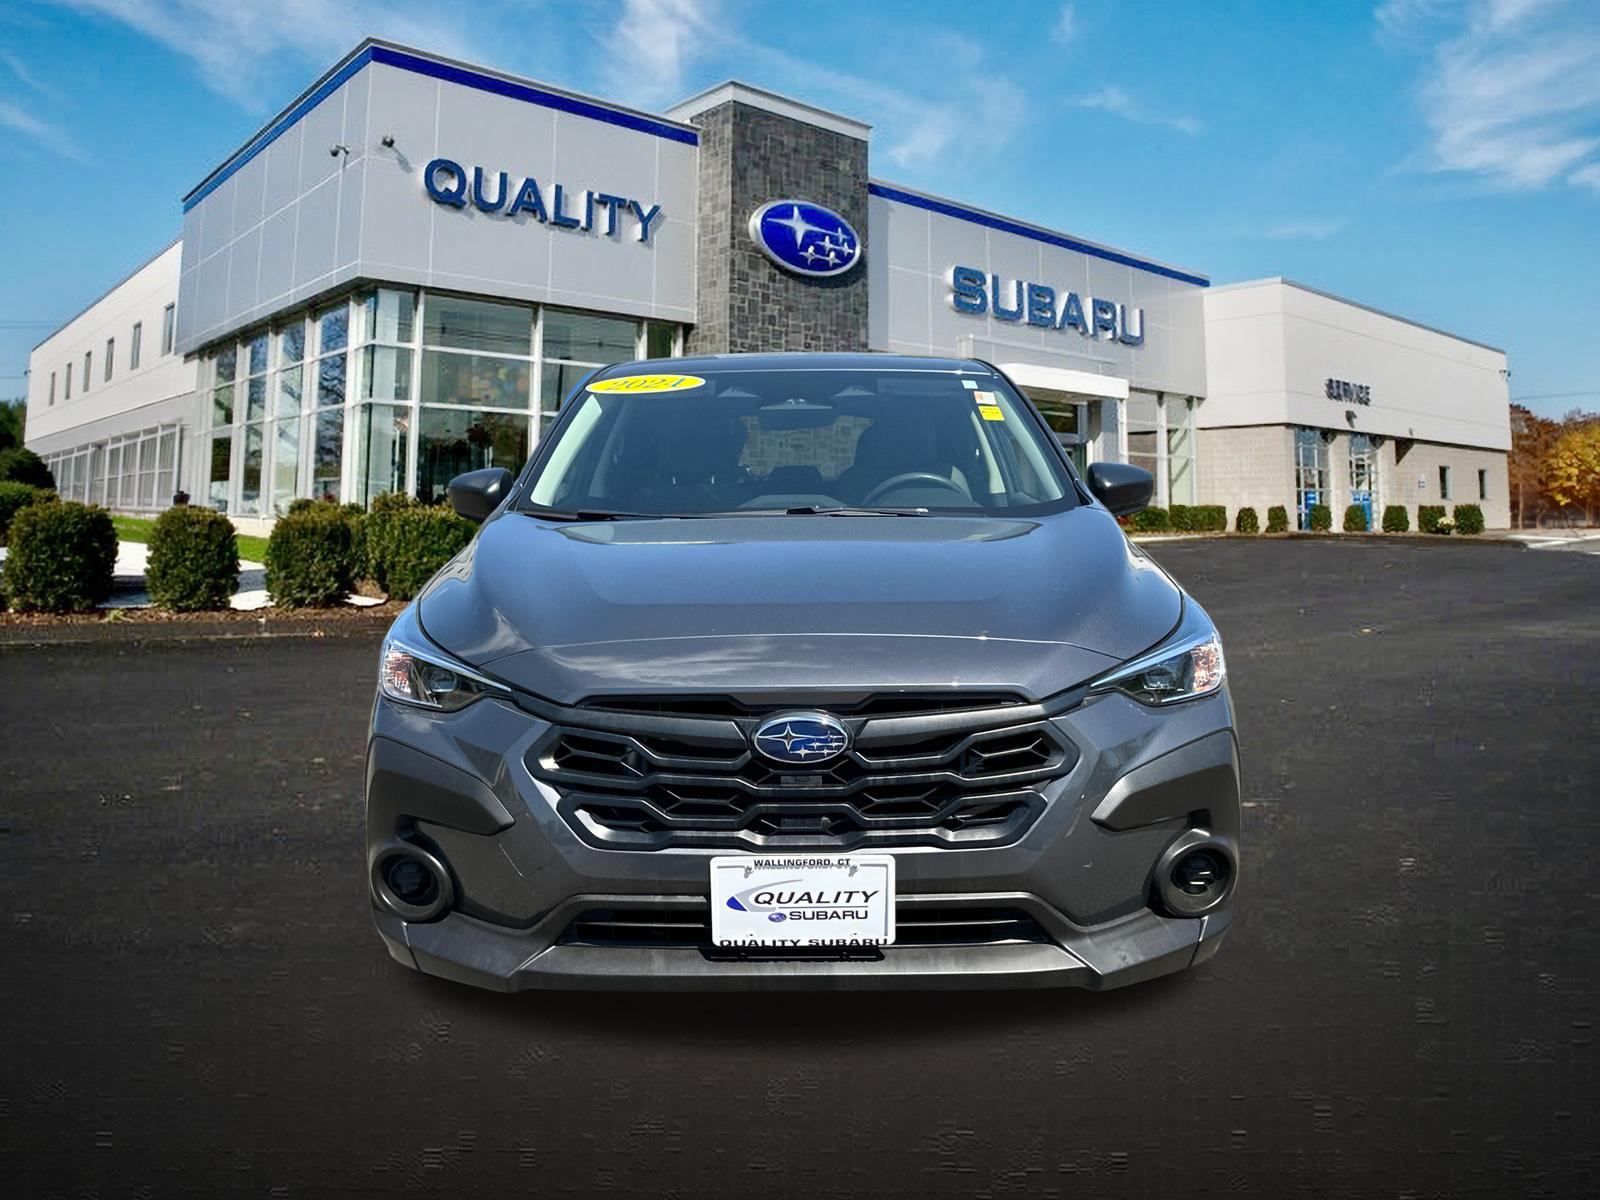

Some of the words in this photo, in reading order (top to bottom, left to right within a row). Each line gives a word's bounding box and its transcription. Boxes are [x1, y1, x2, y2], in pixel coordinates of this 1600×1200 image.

[424, 158, 662, 243] QUALITY
[951, 265, 1145, 347] SUBARU
[838, 858, 851, 866] CT
[754, 890, 879, 905] QUALITY
[789, 909, 869, 921] SUBARU
[719, 939, 801, 947] QUALITY
[808, 938, 888, 946] SUBARU
